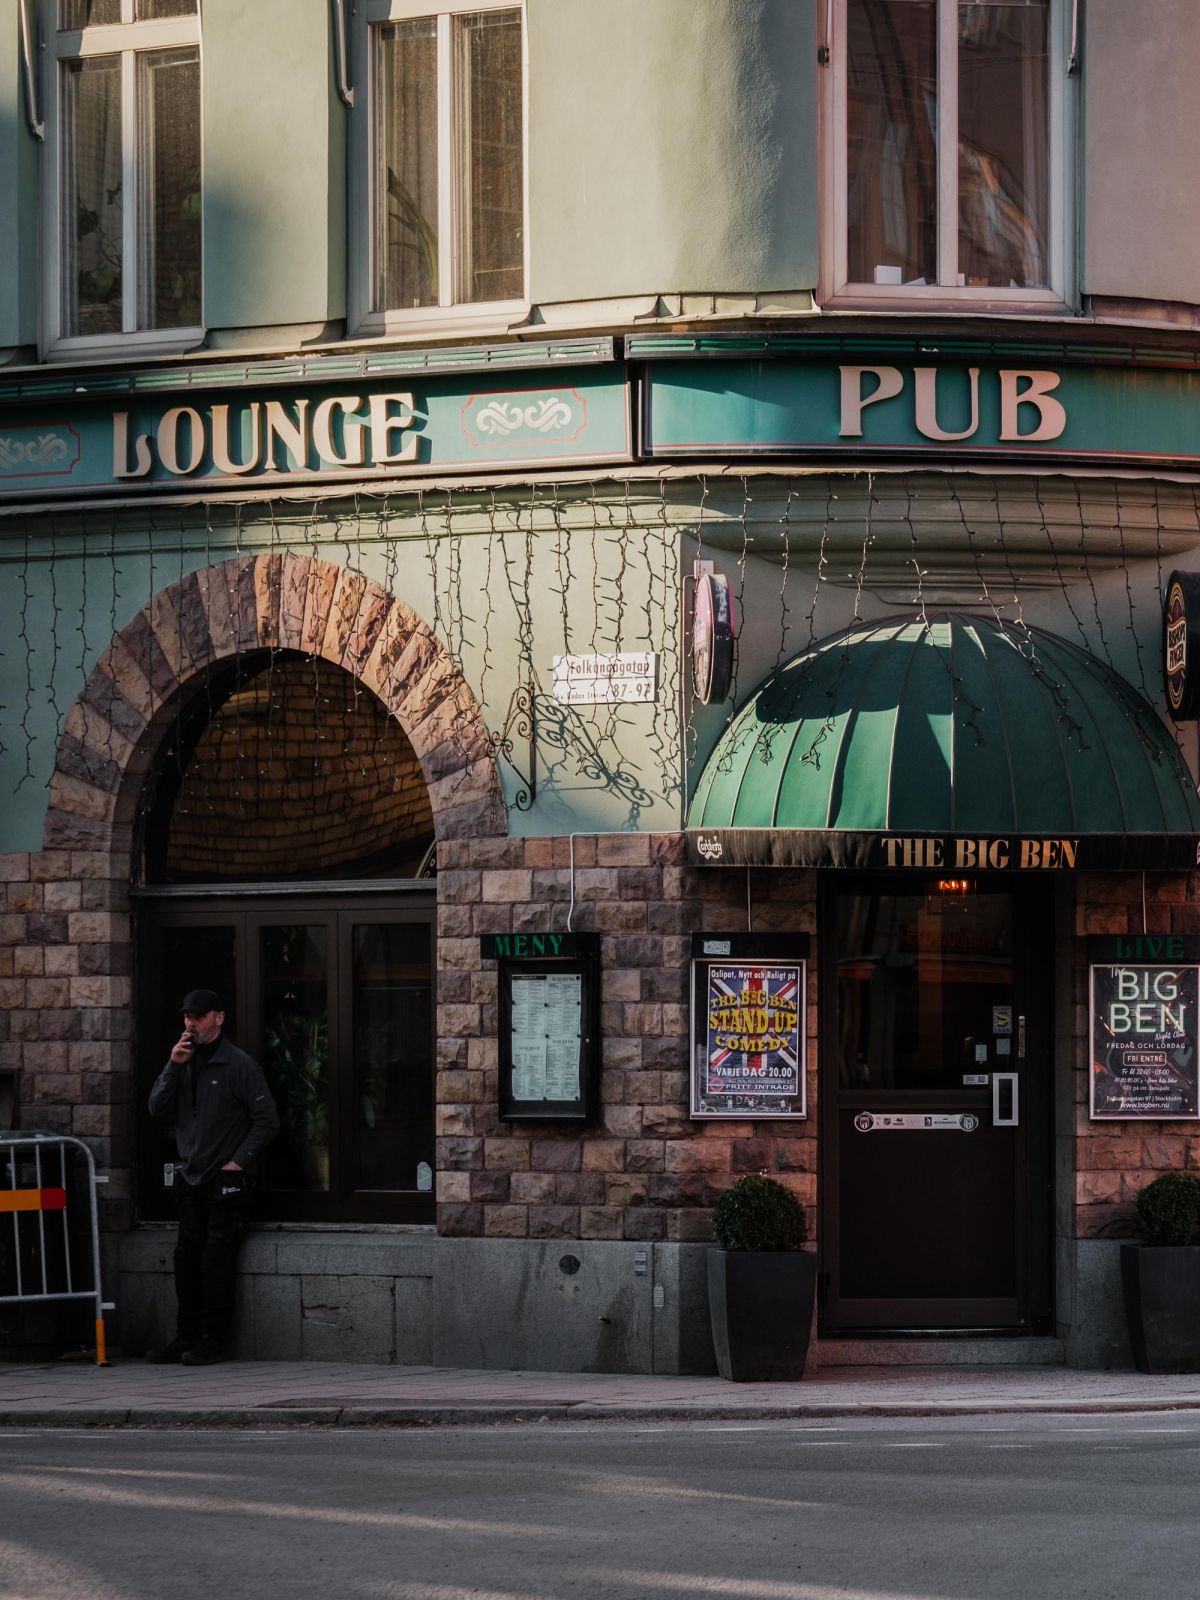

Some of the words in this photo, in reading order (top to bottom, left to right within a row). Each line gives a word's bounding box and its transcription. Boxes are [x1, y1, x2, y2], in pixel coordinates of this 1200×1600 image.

[838, 366, 1067, 441] PUB
[112, 392, 424, 479] LOUNGE
[881, 838, 945, 867] THE
[954, 839, 1010, 869] BIG
[1019, 840, 1080, 869] BEN
[495, 934, 564, 958] MENY
[1115, 936, 1184, 959] LIVE
[711, 969, 737, 980] Oslipat,
[738, 970, 753, 981] Nytt
[754, 970, 765, 979] och
[767, 971, 786, 981] Roligt
[787, 970, 796, 981] på
[1118, 971, 1178, 1001] BIG
[710, 994, 737, 1009] THE
[740, 989, 766, 1007] BIG
[769, 995, 798, 1010] BEN
[709, 1009, 769, 1034] STAND
[774, 1011, 798, 1033] UP
[1110, 1003, 1186, 1033] BEN
[714, 1034, 792, 1053] COMEDY
[1156, 1041, 1186, 1049] LÖRDAG
[1140, 1053, 1164, 1063] ENTRÉ
[716, 1067, 741, 1077] VARJE
[742, 1066, 766, 1078] DAG
[768, 1066, 792, 1078] 20.00
[754, 1082, 795, 1091] INTRÄDE
